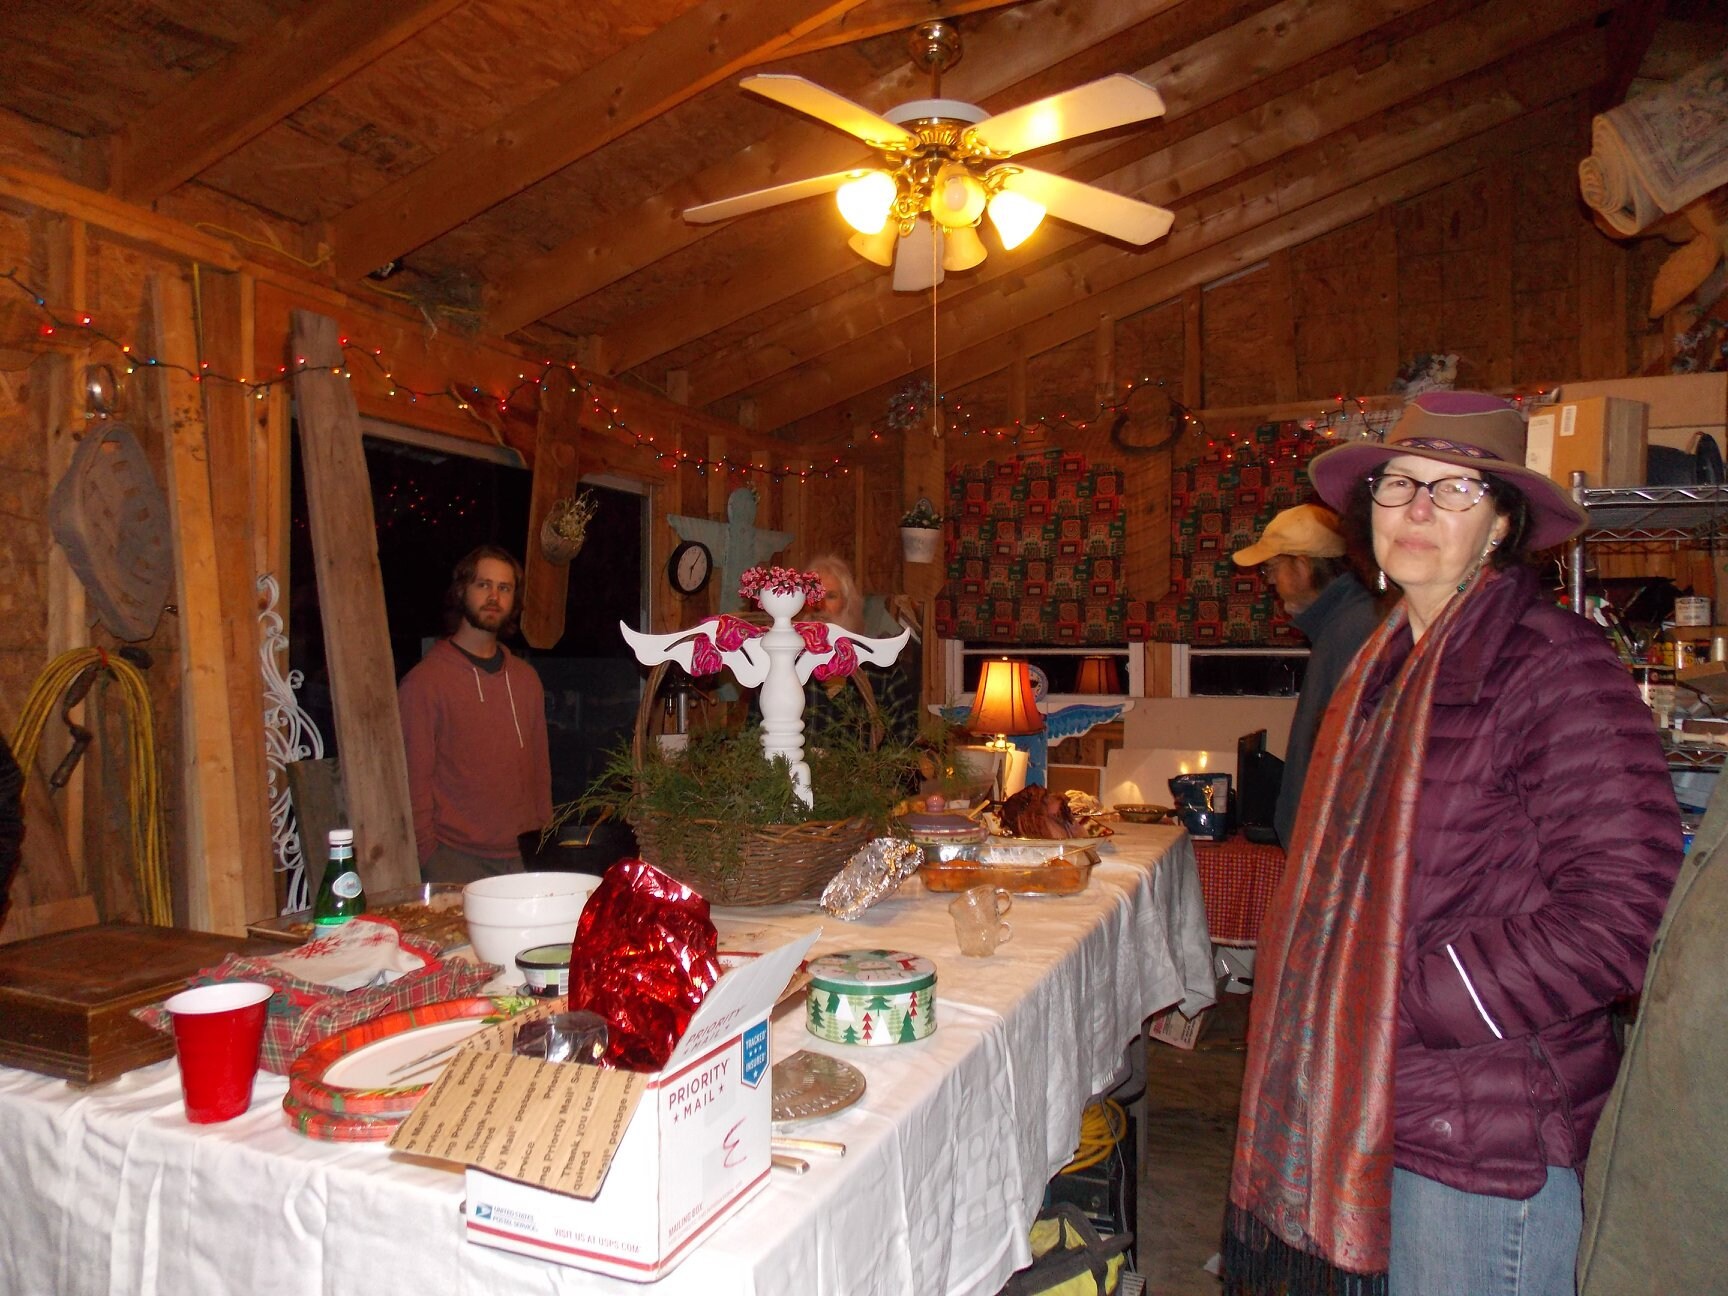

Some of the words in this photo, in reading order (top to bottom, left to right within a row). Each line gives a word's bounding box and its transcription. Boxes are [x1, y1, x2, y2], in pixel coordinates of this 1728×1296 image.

[686, 1008, 741, 1046] PRIORITY
[745, 1030, 767, 1050] TRACKED
[514, 1081, 537, 1122] postage
[668, 1059, 729, 1110] PRIORITY
[609, 1097, 628, 1145] postage
[684, 1089, 715, 1120] MAIL
[464, 1117, 488, 1152] Thank
[543, 1117, 567, 1162] Priority
[560, 1140, 581, 1178] Thank
[576, 1115, 588, 1137] you
[582, 1095, 594, 1112] for
[573, 1151, 591, 1191] quired
[492, 1215, 513, 1228] POSTAL
[493, 1205, 514, 1218] UNITED
[514, 1210, 535, 1222] STATES
[667, 1211, 692, 1238] MAILING
[691, 1202, 703, 1219] BOX
[554, 1227, 573, 1239] VISIT
[575, 1232, 586, 1243] US
[587, 1234, 598, 1245] AT
